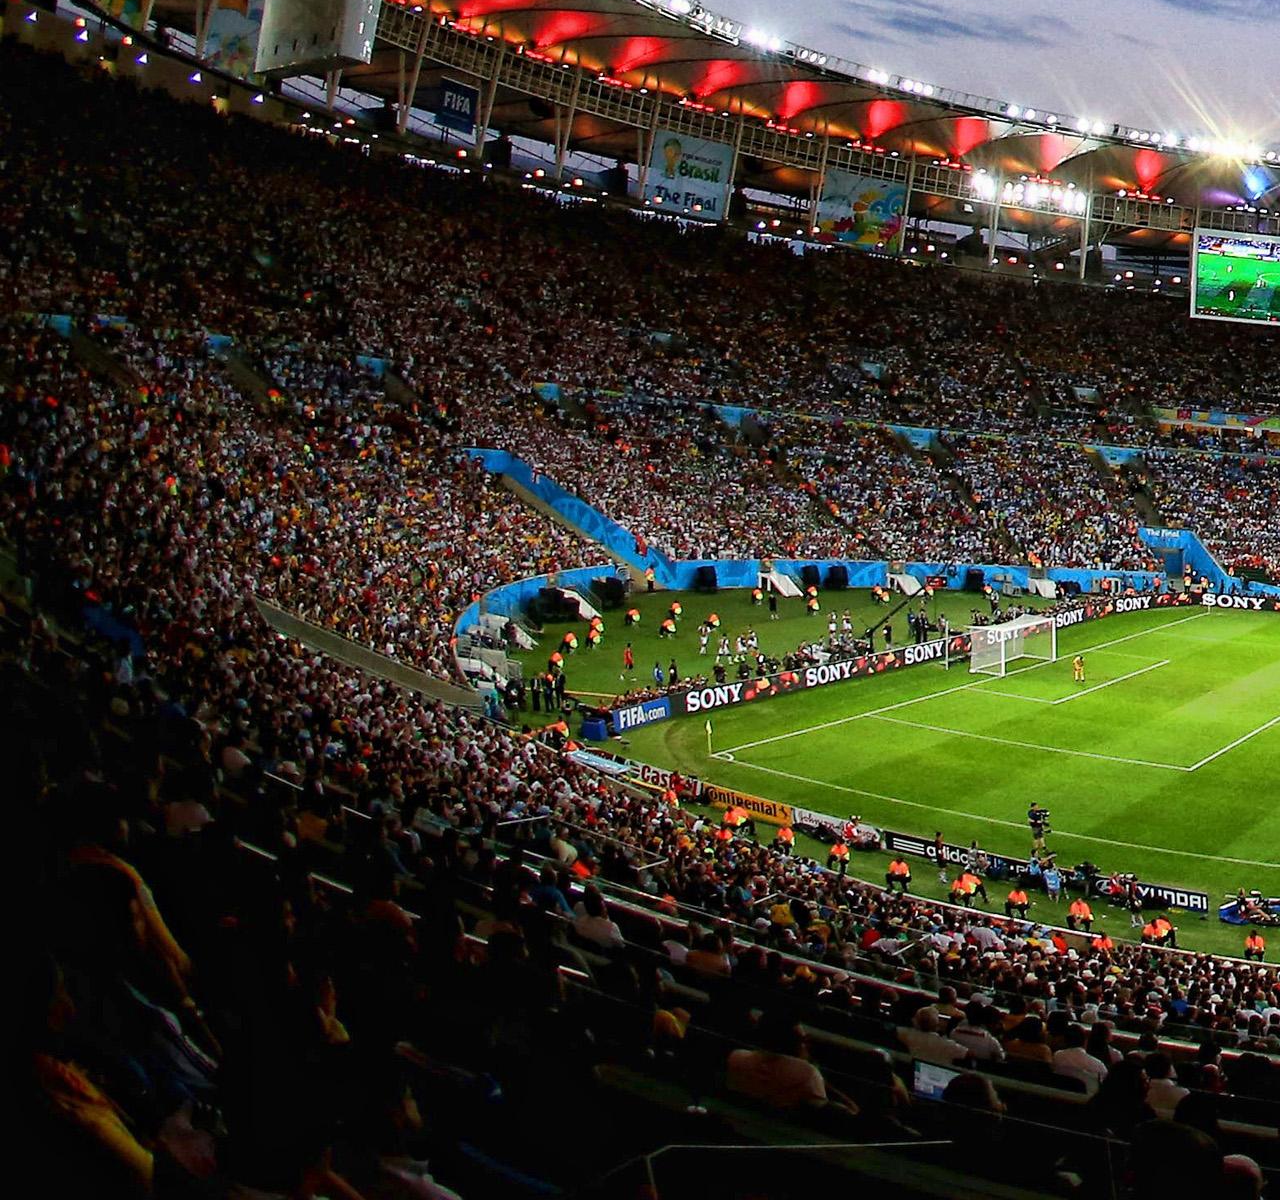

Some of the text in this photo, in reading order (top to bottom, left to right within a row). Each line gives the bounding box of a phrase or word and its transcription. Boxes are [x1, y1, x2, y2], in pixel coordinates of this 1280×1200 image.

[444, 91, 470, 115] FIFA
[679, 161, 720, 183] Brasil
[1116, 596, 1152, 612] SONY
[1202, 593, 1265, 609] SONY
[1056, 608, 1084, 627] SONY
[904, 641, 944, 665] SONY
[806, 662, 852, 687] SONY
[686, 683, 742, 712] SONY
